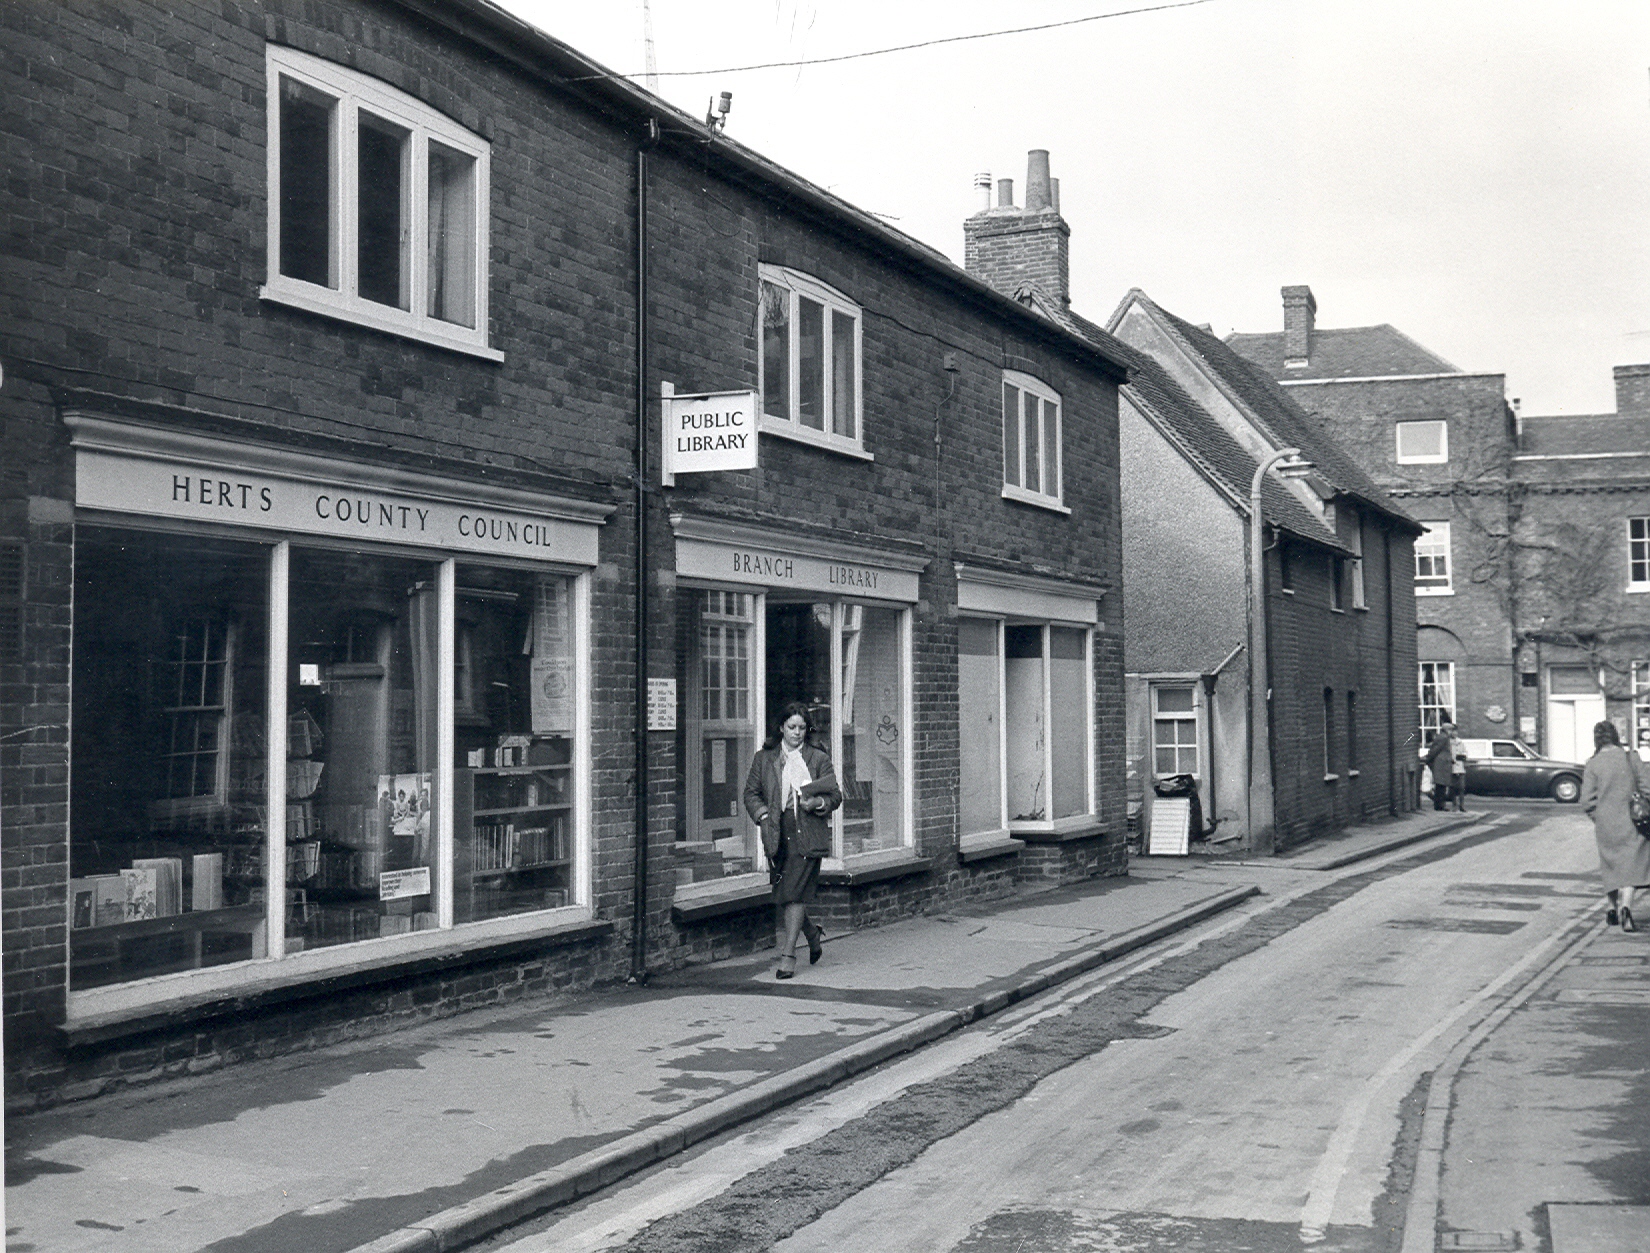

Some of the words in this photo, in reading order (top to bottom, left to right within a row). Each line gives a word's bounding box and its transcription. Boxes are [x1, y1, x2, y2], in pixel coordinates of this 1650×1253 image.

[680, 411, 744, 430] PUBLIC
[677, 433, 749, 453] LIBRARY
[172, 474, 273, 512] HERTS
[315, 495, 429, 531] COUNTY
[458, 515, 551, 548] COUNCIL
[733, 552, 794, 579] BRANCH
[829, 565, 879, 590] LIBRARY
